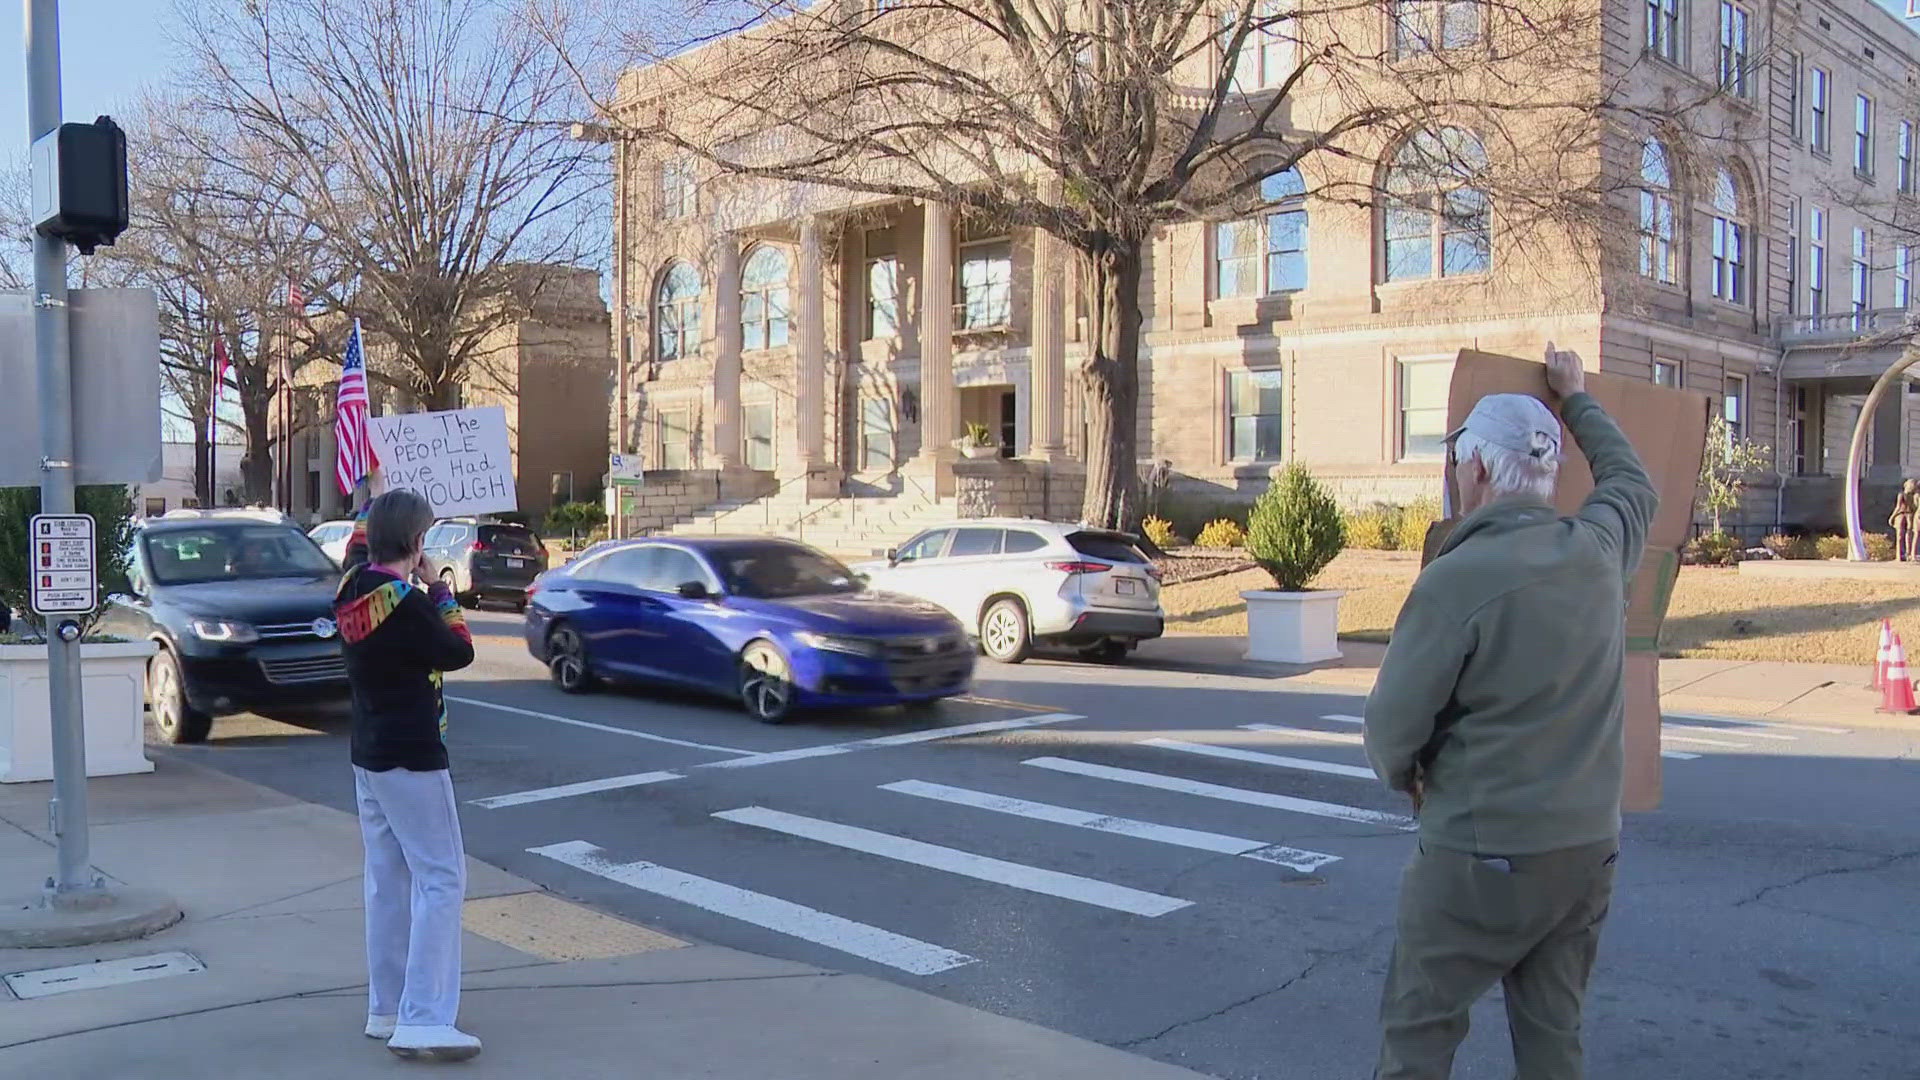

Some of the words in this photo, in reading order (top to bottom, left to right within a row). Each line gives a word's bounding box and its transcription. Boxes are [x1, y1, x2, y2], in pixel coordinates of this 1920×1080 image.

[377, 419, 417, 444] We
[433, 413, 480, 436] The
[394, 435, 478, 464] PEOPLE
[450, 453, 496, 477] Had
[398, 475, 506, 506] NOUGH
